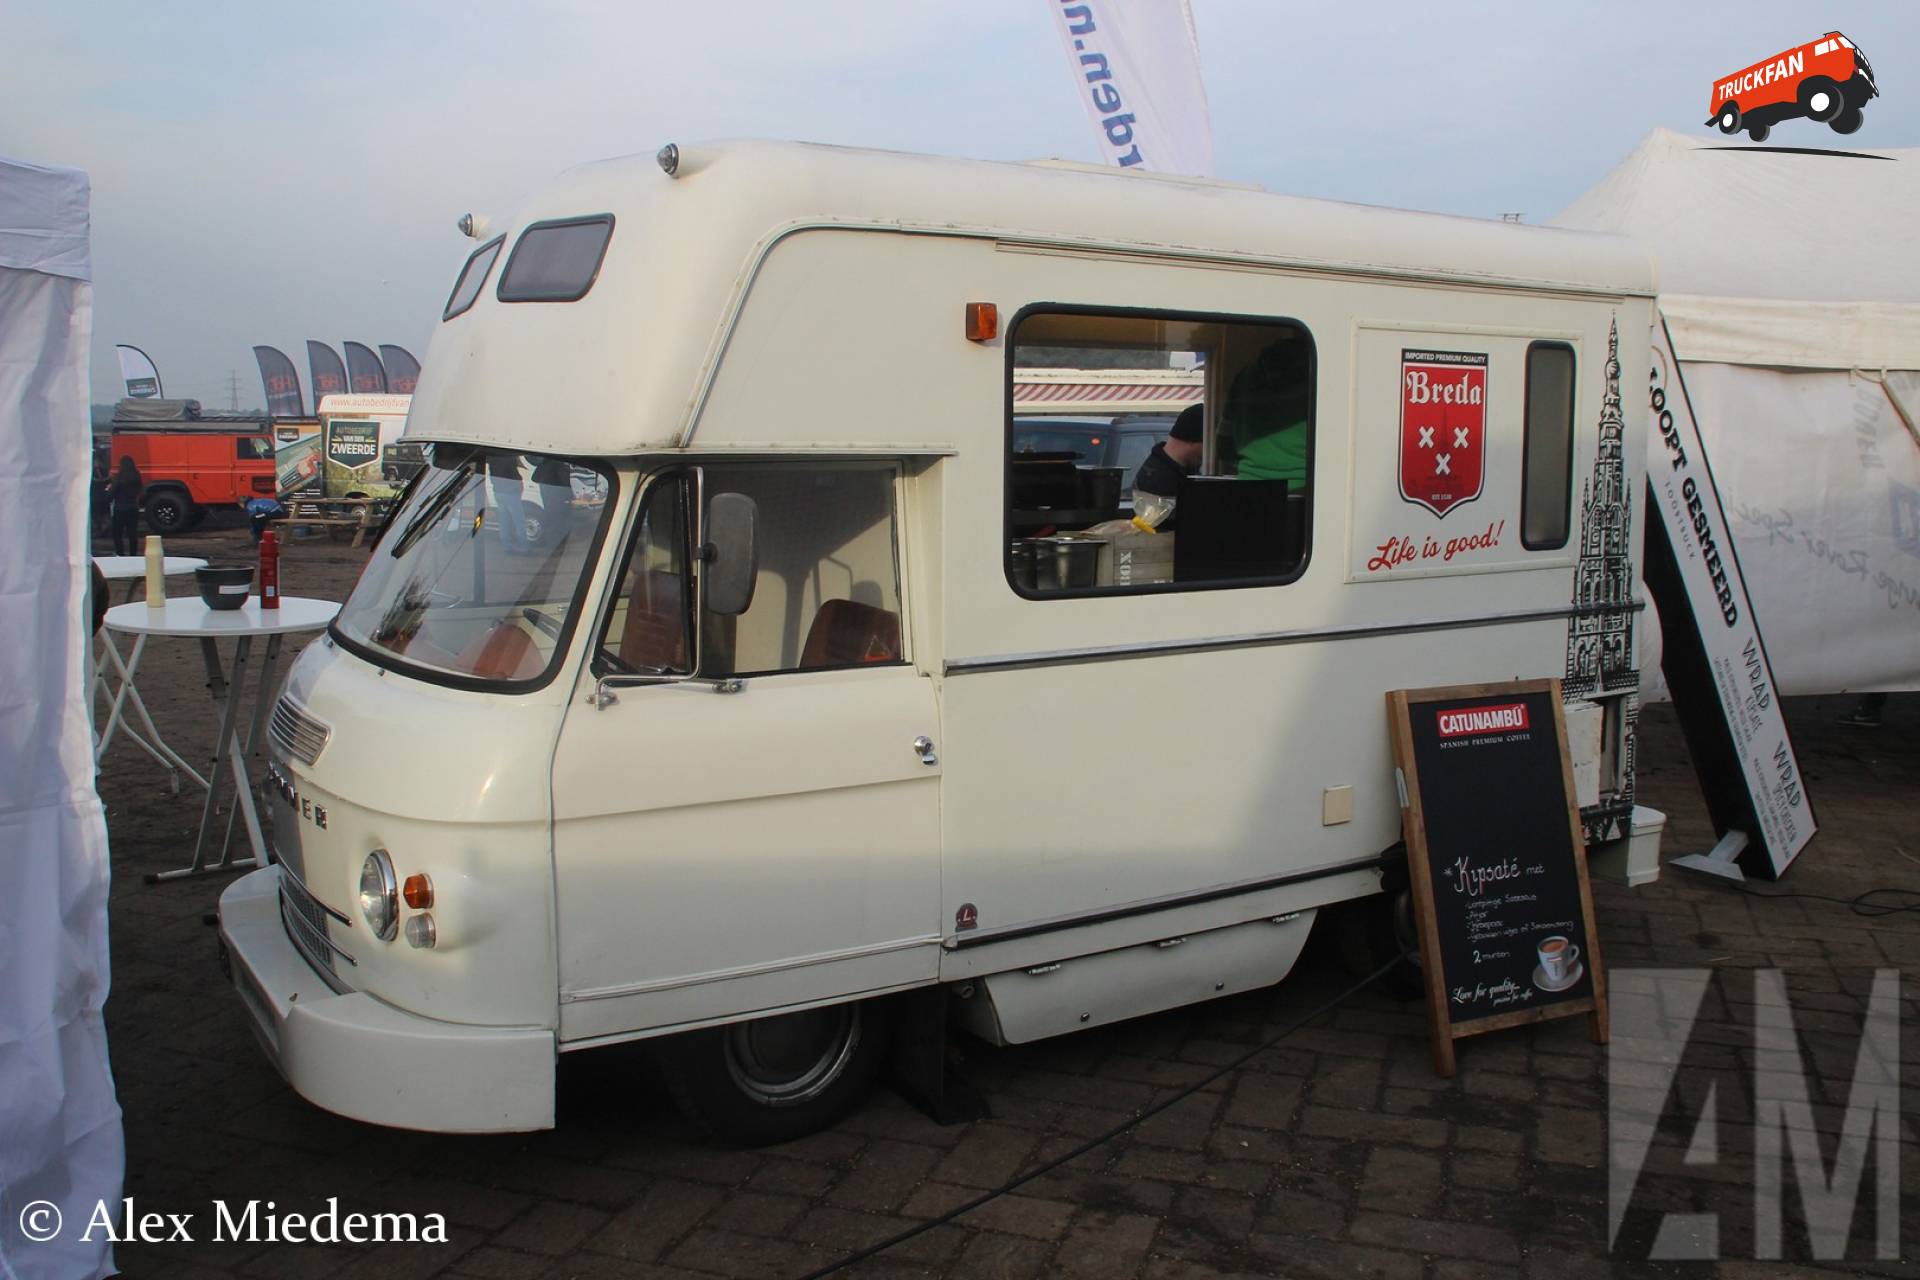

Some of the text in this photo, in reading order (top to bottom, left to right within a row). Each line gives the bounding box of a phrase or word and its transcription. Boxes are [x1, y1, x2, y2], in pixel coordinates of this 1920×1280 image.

[1405, 351, 1486, 363] IMPORTED PREMIUM QUALITY
[1406, 370, 1482, 405] Breda
[331, 443, 376, 455] ZWEERDE
[1368, 520, 1504, 571] Life is good!
[1682, 476, 1738, 629] GESMEERD
[1741, 638, 1771, 712] WRAP
[1440, 733, 1531, 750] SPANISH PREMIUM COFFEE
[1772, 740, 1801, 808] WRAP
[1454, 856, 1521, 896] Kipsaté
[1473, 950, 1481, 964] 2
[1452, 985, 1473, 1004] Love
[1472, 983, 1487, 1002] for
